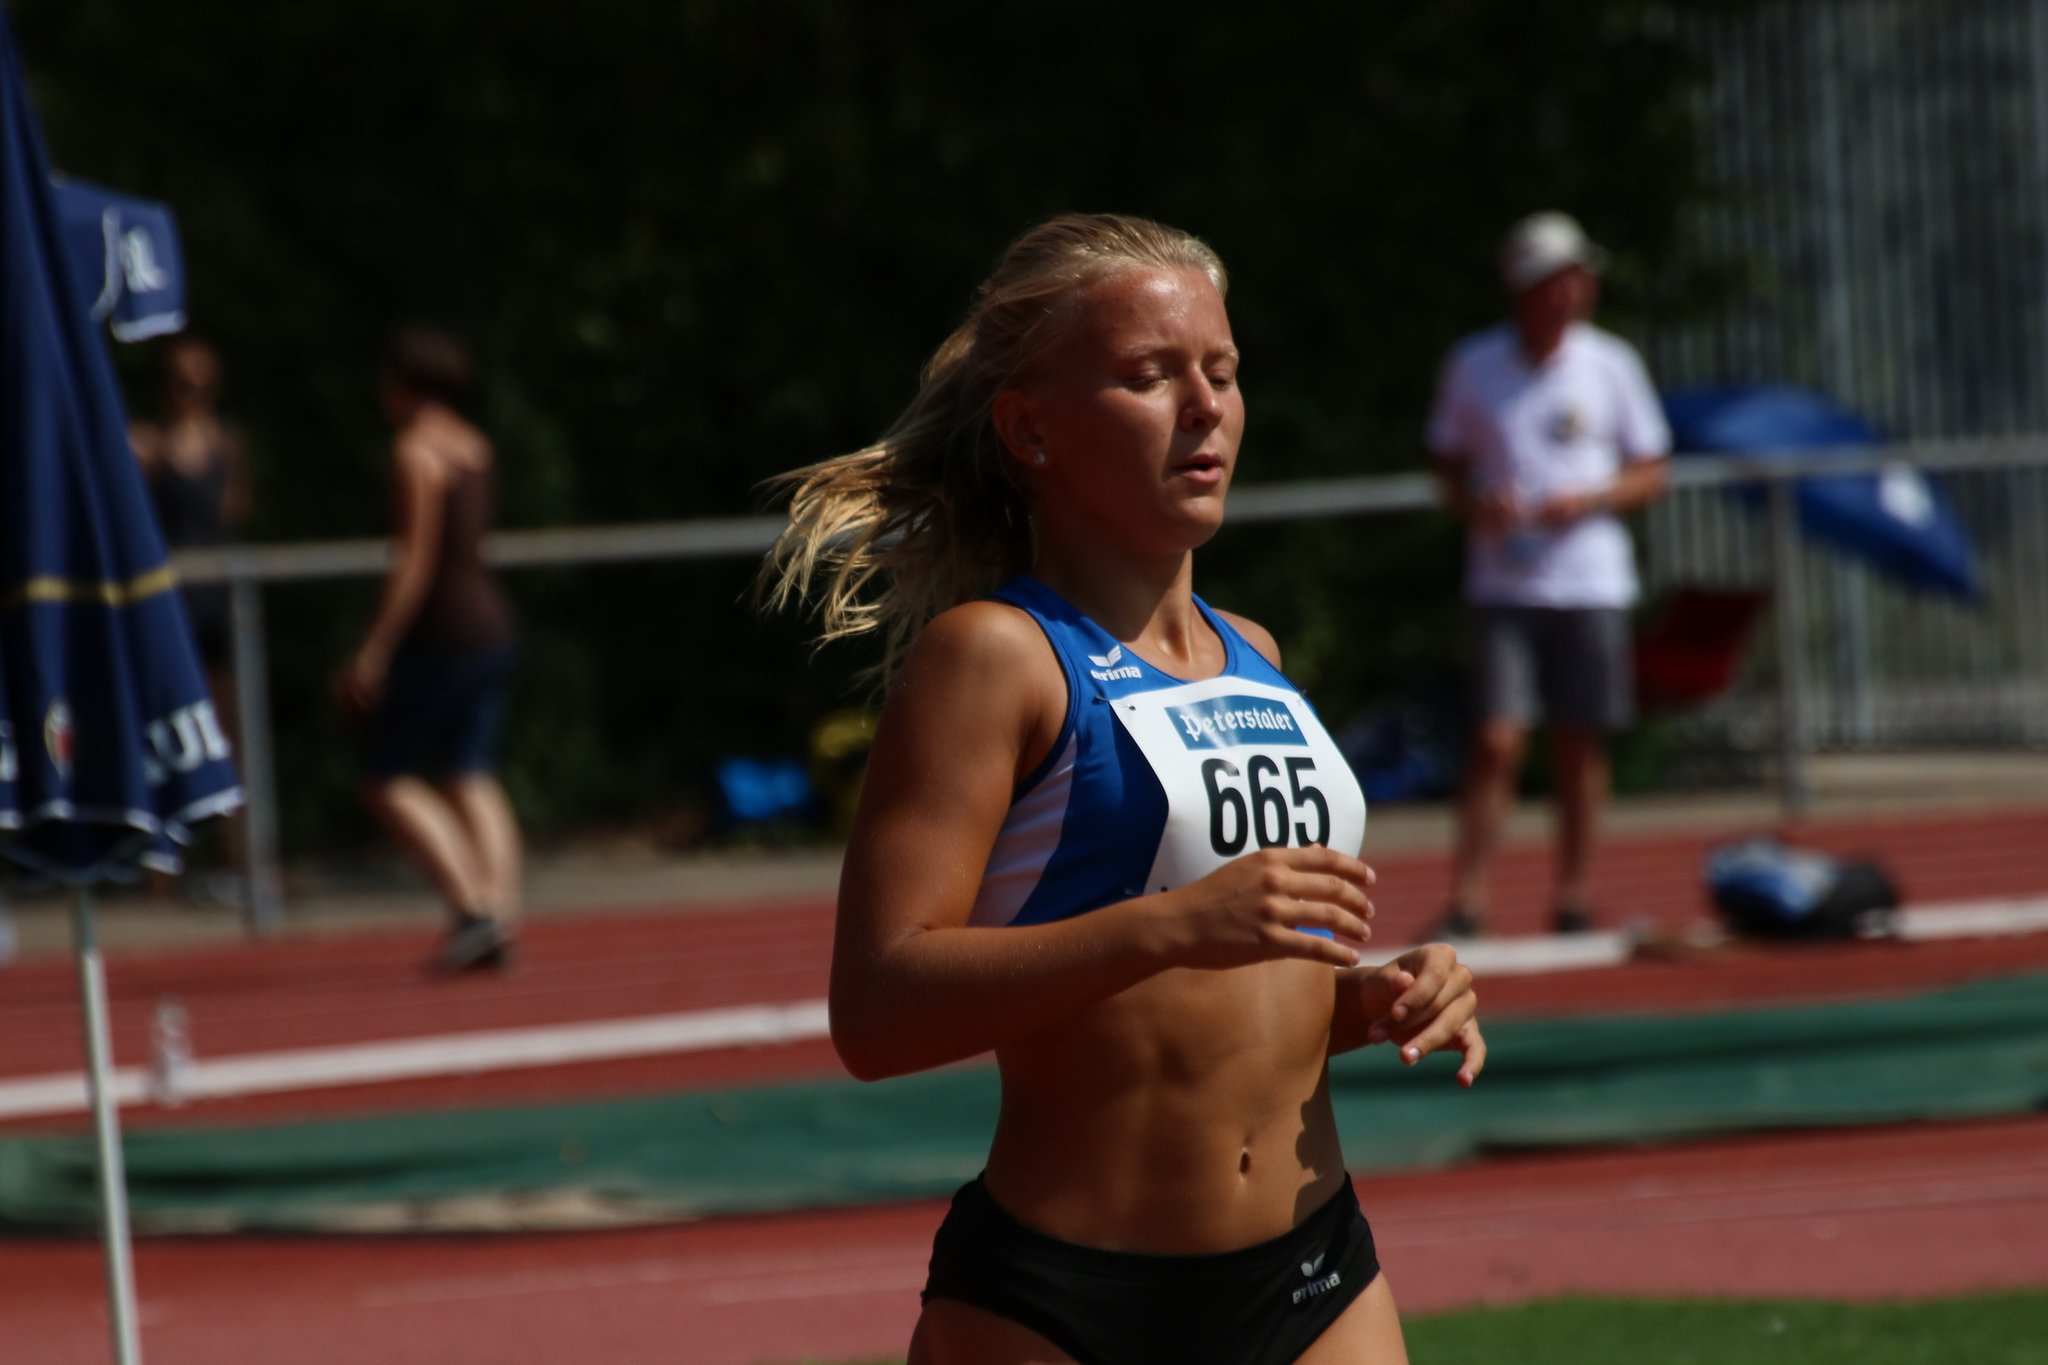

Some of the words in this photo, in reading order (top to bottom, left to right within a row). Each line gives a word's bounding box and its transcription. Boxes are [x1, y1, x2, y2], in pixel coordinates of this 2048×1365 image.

[1089, 665, 1142, 682] erima
[1179, 707, 1294, 742] Peterstaler
[1201, 754, 1330, 858] 665
[1292, 1272, 1341, 1305] erima
